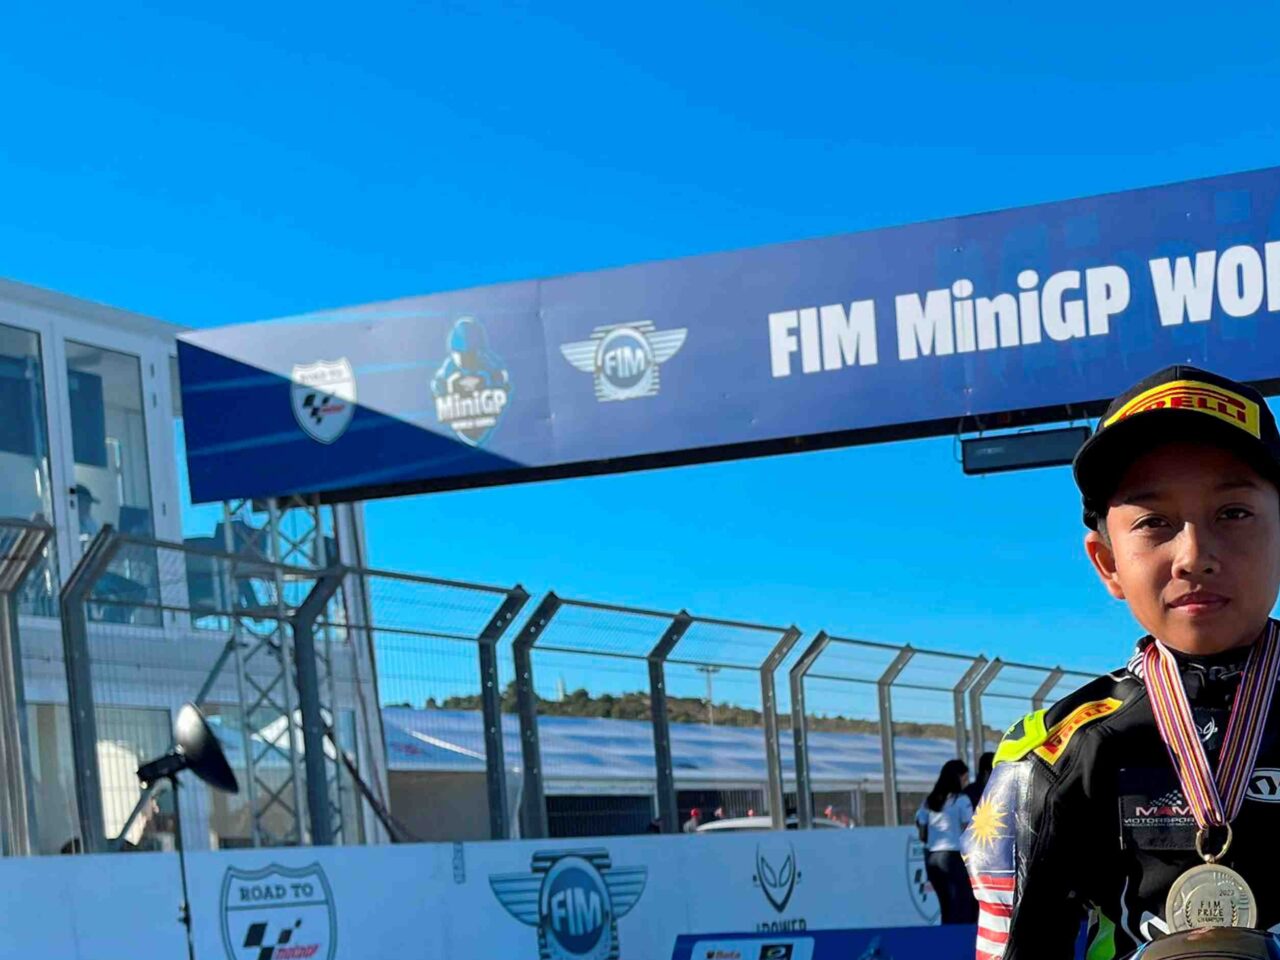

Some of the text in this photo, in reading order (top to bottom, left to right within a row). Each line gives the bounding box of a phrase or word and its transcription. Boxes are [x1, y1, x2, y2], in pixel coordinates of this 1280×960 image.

[768, 299, 878, 378] FIM
[895, 264, 1131, 361] MiniGP
[604, 345, 645, 378] FIM
[435, 387, 507, 422] MiniGP
[239, 882, 314, 900] ROAD TO
[551, 888, 602, 936] FIM
